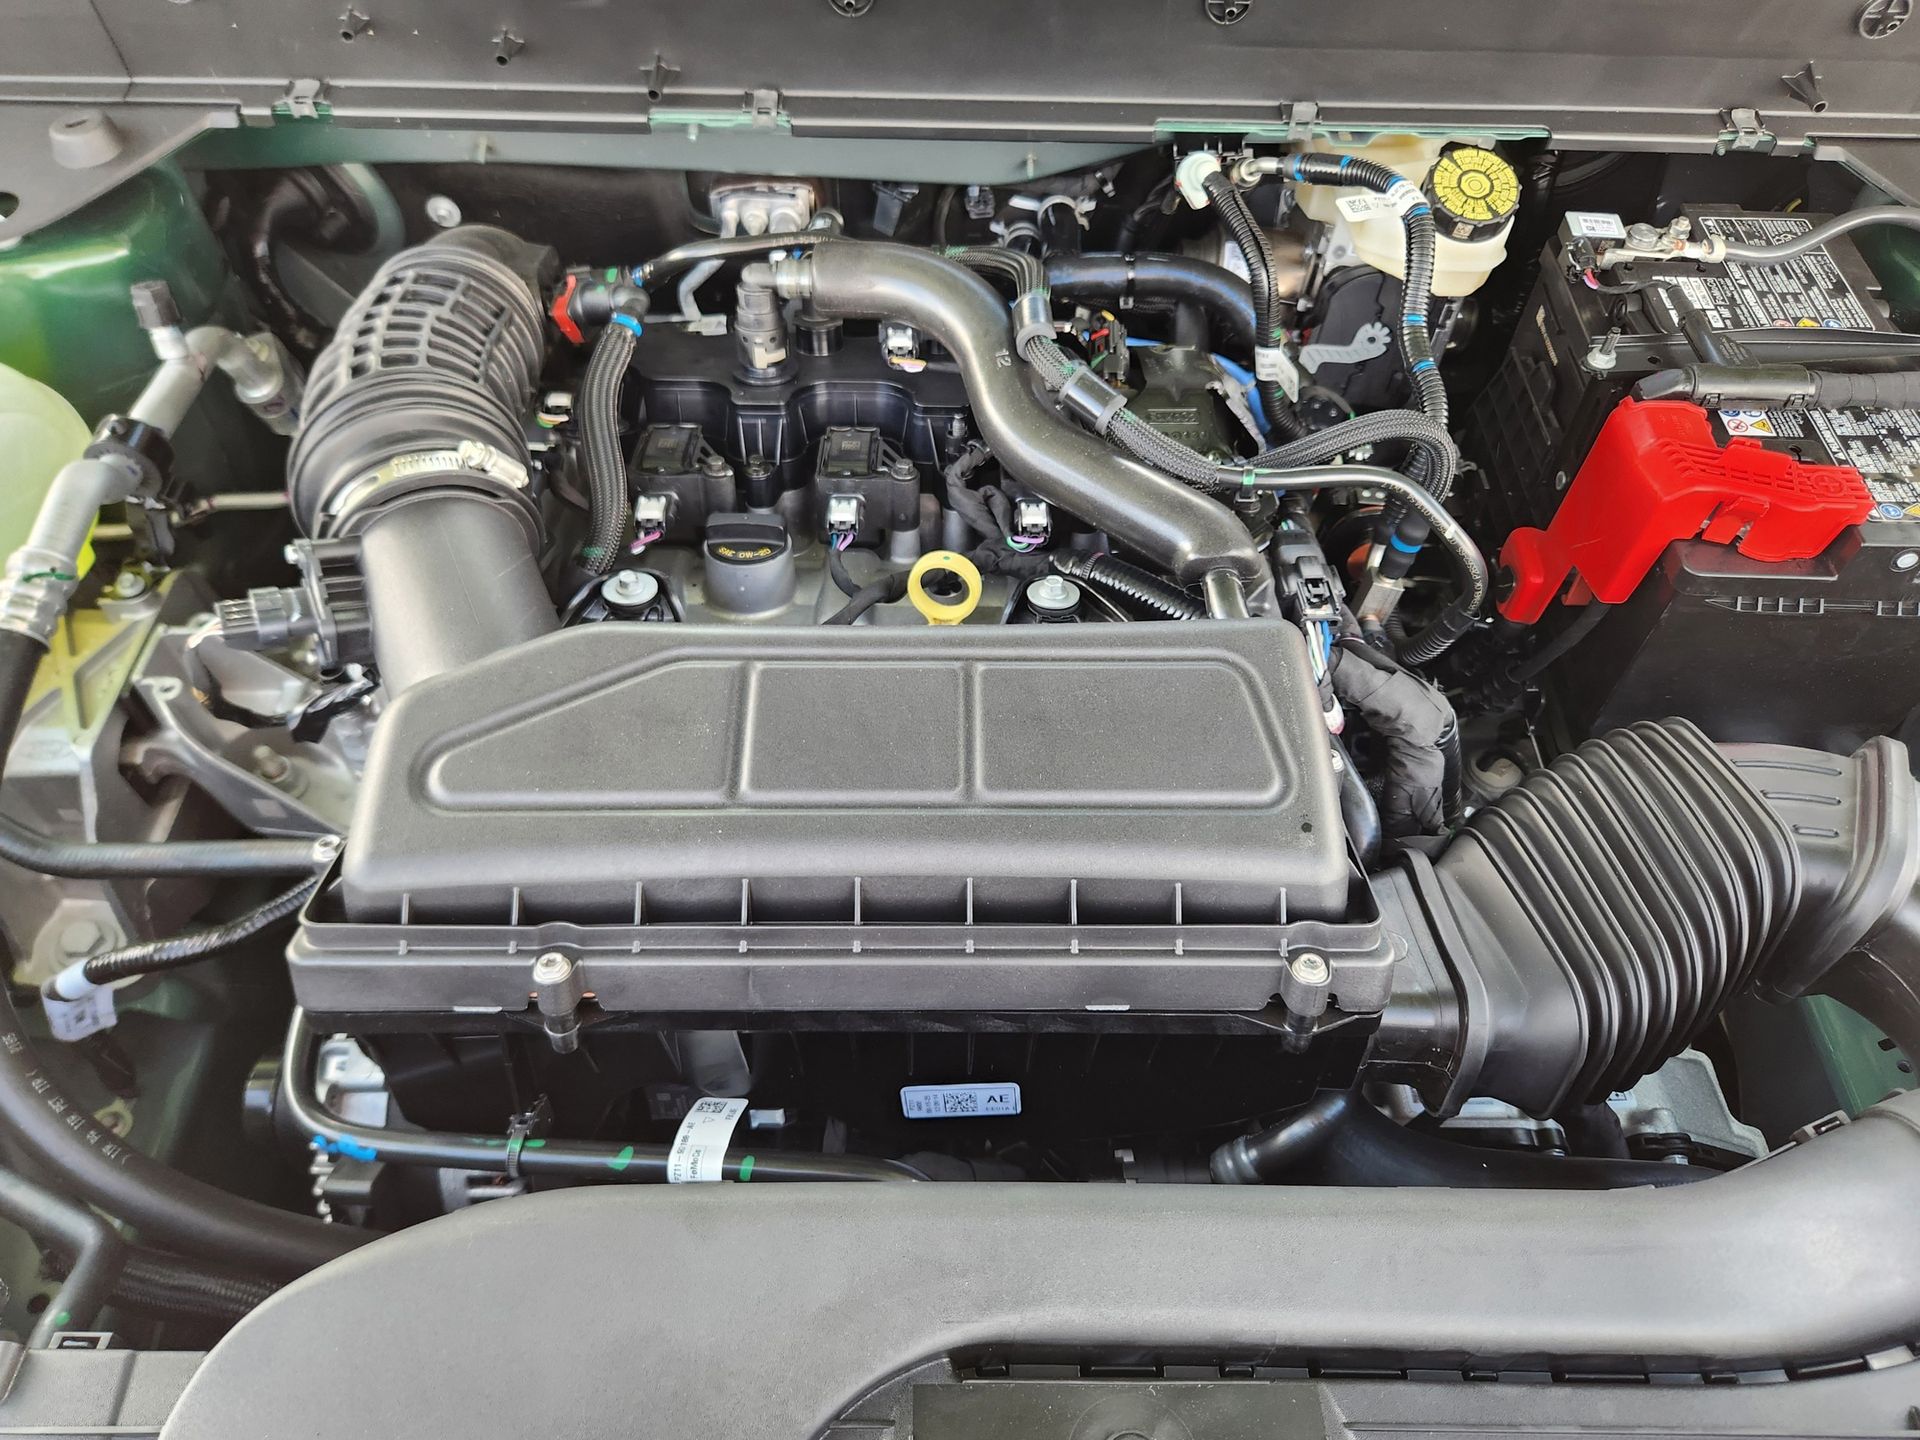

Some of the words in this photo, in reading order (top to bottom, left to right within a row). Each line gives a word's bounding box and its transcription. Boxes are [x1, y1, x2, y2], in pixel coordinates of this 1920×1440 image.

[1702, 278, 1726, 303] FoMoCo
[718, 546, 736, 557] SAE
[987, 1094, 1010, 1104] AE
[690, 1149, 702, 1179] FoMoCo
